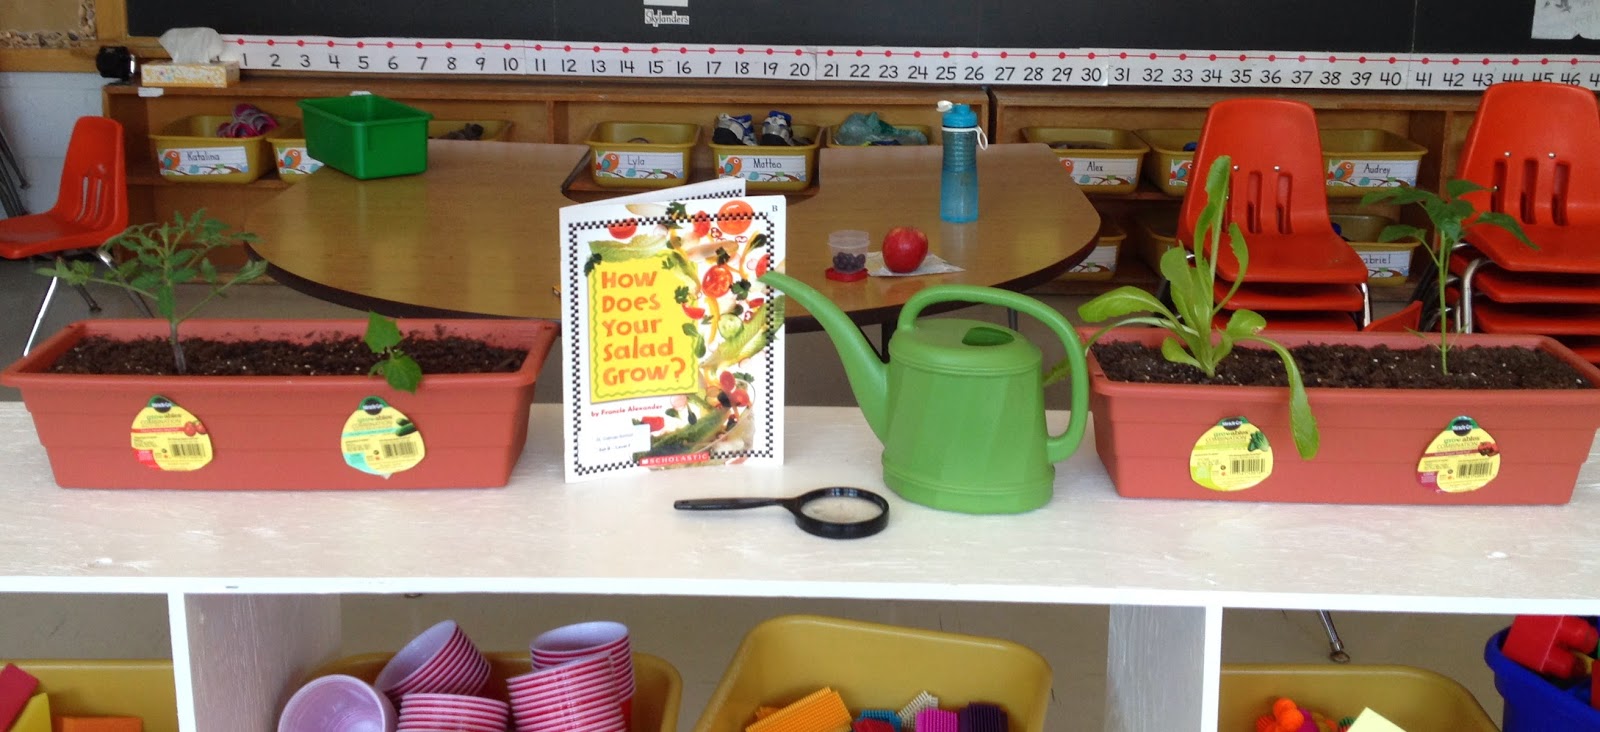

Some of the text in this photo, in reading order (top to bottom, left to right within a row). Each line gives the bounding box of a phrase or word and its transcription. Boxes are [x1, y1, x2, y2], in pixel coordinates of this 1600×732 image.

[645, 9, 689, 27] Skylanders
[269, 53, 282, 68] 2
[300, 54, 311, 68] 3
[328, 54, 341, 69] 4
[357, 55, 370, 70] 5
[387, 55, 399, 71] 6
[416, 56, 428, 71] 7
[447, 56, 457, 71] 8
[475, 57, 486, 71] 9
[503, 57, 519, 72] 10
[535, 58, 546, 72] 11
[561, 58, 577, 73] 12
[591, 59, 607, 73] 13
[620, 60, 635, 74] 14
[648, 60, 664, 75] 15
[677, 60, 692, 75] 16
[706, 61, 722, 75] 17
[735, 61, 750, 75] 18
[763, 61, 779, 76] 19
[789, 62, 810, 77] 20
[823, 63, 839, 78] 21
[849, 63, 870, 79] 22
[878, 64, 899, 79] 23
[907, 65, 929, 80] 24
[935, 65, 957, 81] 25
[963, 65, 985, 81] 26
[994, 66, 1016, 81] 27
[1023, 66, 1045, 82] 28
[1051, 67, 1073, 82] 29
[1080, 67, 1102, 83] 30
[1113, 67, 1131, 82] 31
[1142, 67, 1164, 83] 32
[1171, 68, 1194, 83] 33
[1200, 68, 1223, 84] 34
[1229, 68, 1253, 84] 35
[1259, 69, 1282, 85] 36
[1290, 70, 1314, 85] 37
[1319, 70, 1342, 86] 38
[1349, 71, 1373, 87] 39
[1379, 71, 1402, 87] 40
[1415, 71, 1433, 87] 41
[1442, 72, 1465, 87] 42
[1472, 72, 1494, 88] 43
[1501, 72, 1524, 83] 44
[1532, 71, 1555, 83] 45
[1559, 72, 1581, 87] 46
[1589, 72, 1600, 88] 4
[187, 151, 220, 161] Katalina
[627, 155, 645, 167] Lyla
[753, 158, 782, 169] Matteo
[1087, 161, 1104, 172] Alex
[1363, 163, 1391, 178] Audrey
[1363, 254, 1391, 264] abriel
[601, 271, 657, 289] How
[602, 293, 661, 313] Does
[601, 318, 663, 337] Your
[603, 335, 674, 362] Salad
[603, 357, 686, 386] Grow?
[628, 404, 663, 412] Alexander
[650, 454, 707, 463] SCHOLASTIC
